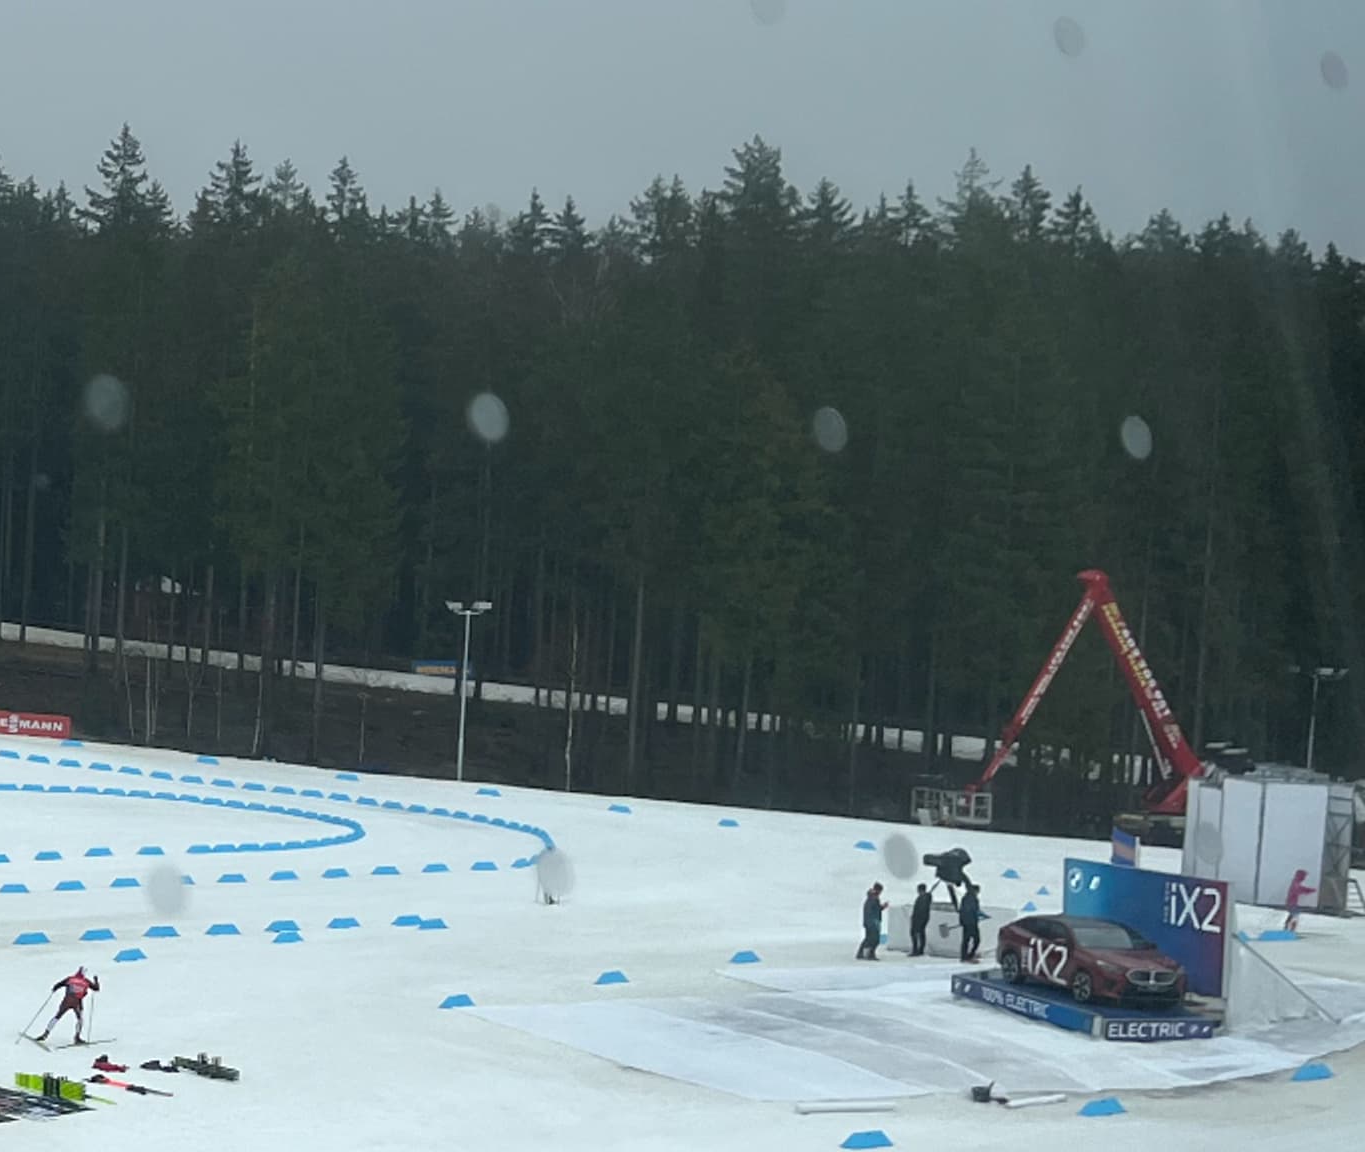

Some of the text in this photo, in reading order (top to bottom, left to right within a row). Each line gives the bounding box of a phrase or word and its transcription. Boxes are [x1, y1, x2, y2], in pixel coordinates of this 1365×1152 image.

[1170, 882, 1221, 933] iX2
[1029, 937, 1068, 986] iX2
[1005, 993, 1050, 1019] ELECTRIC
[1108, 1022, 1185, 1038] ELECTRIC
